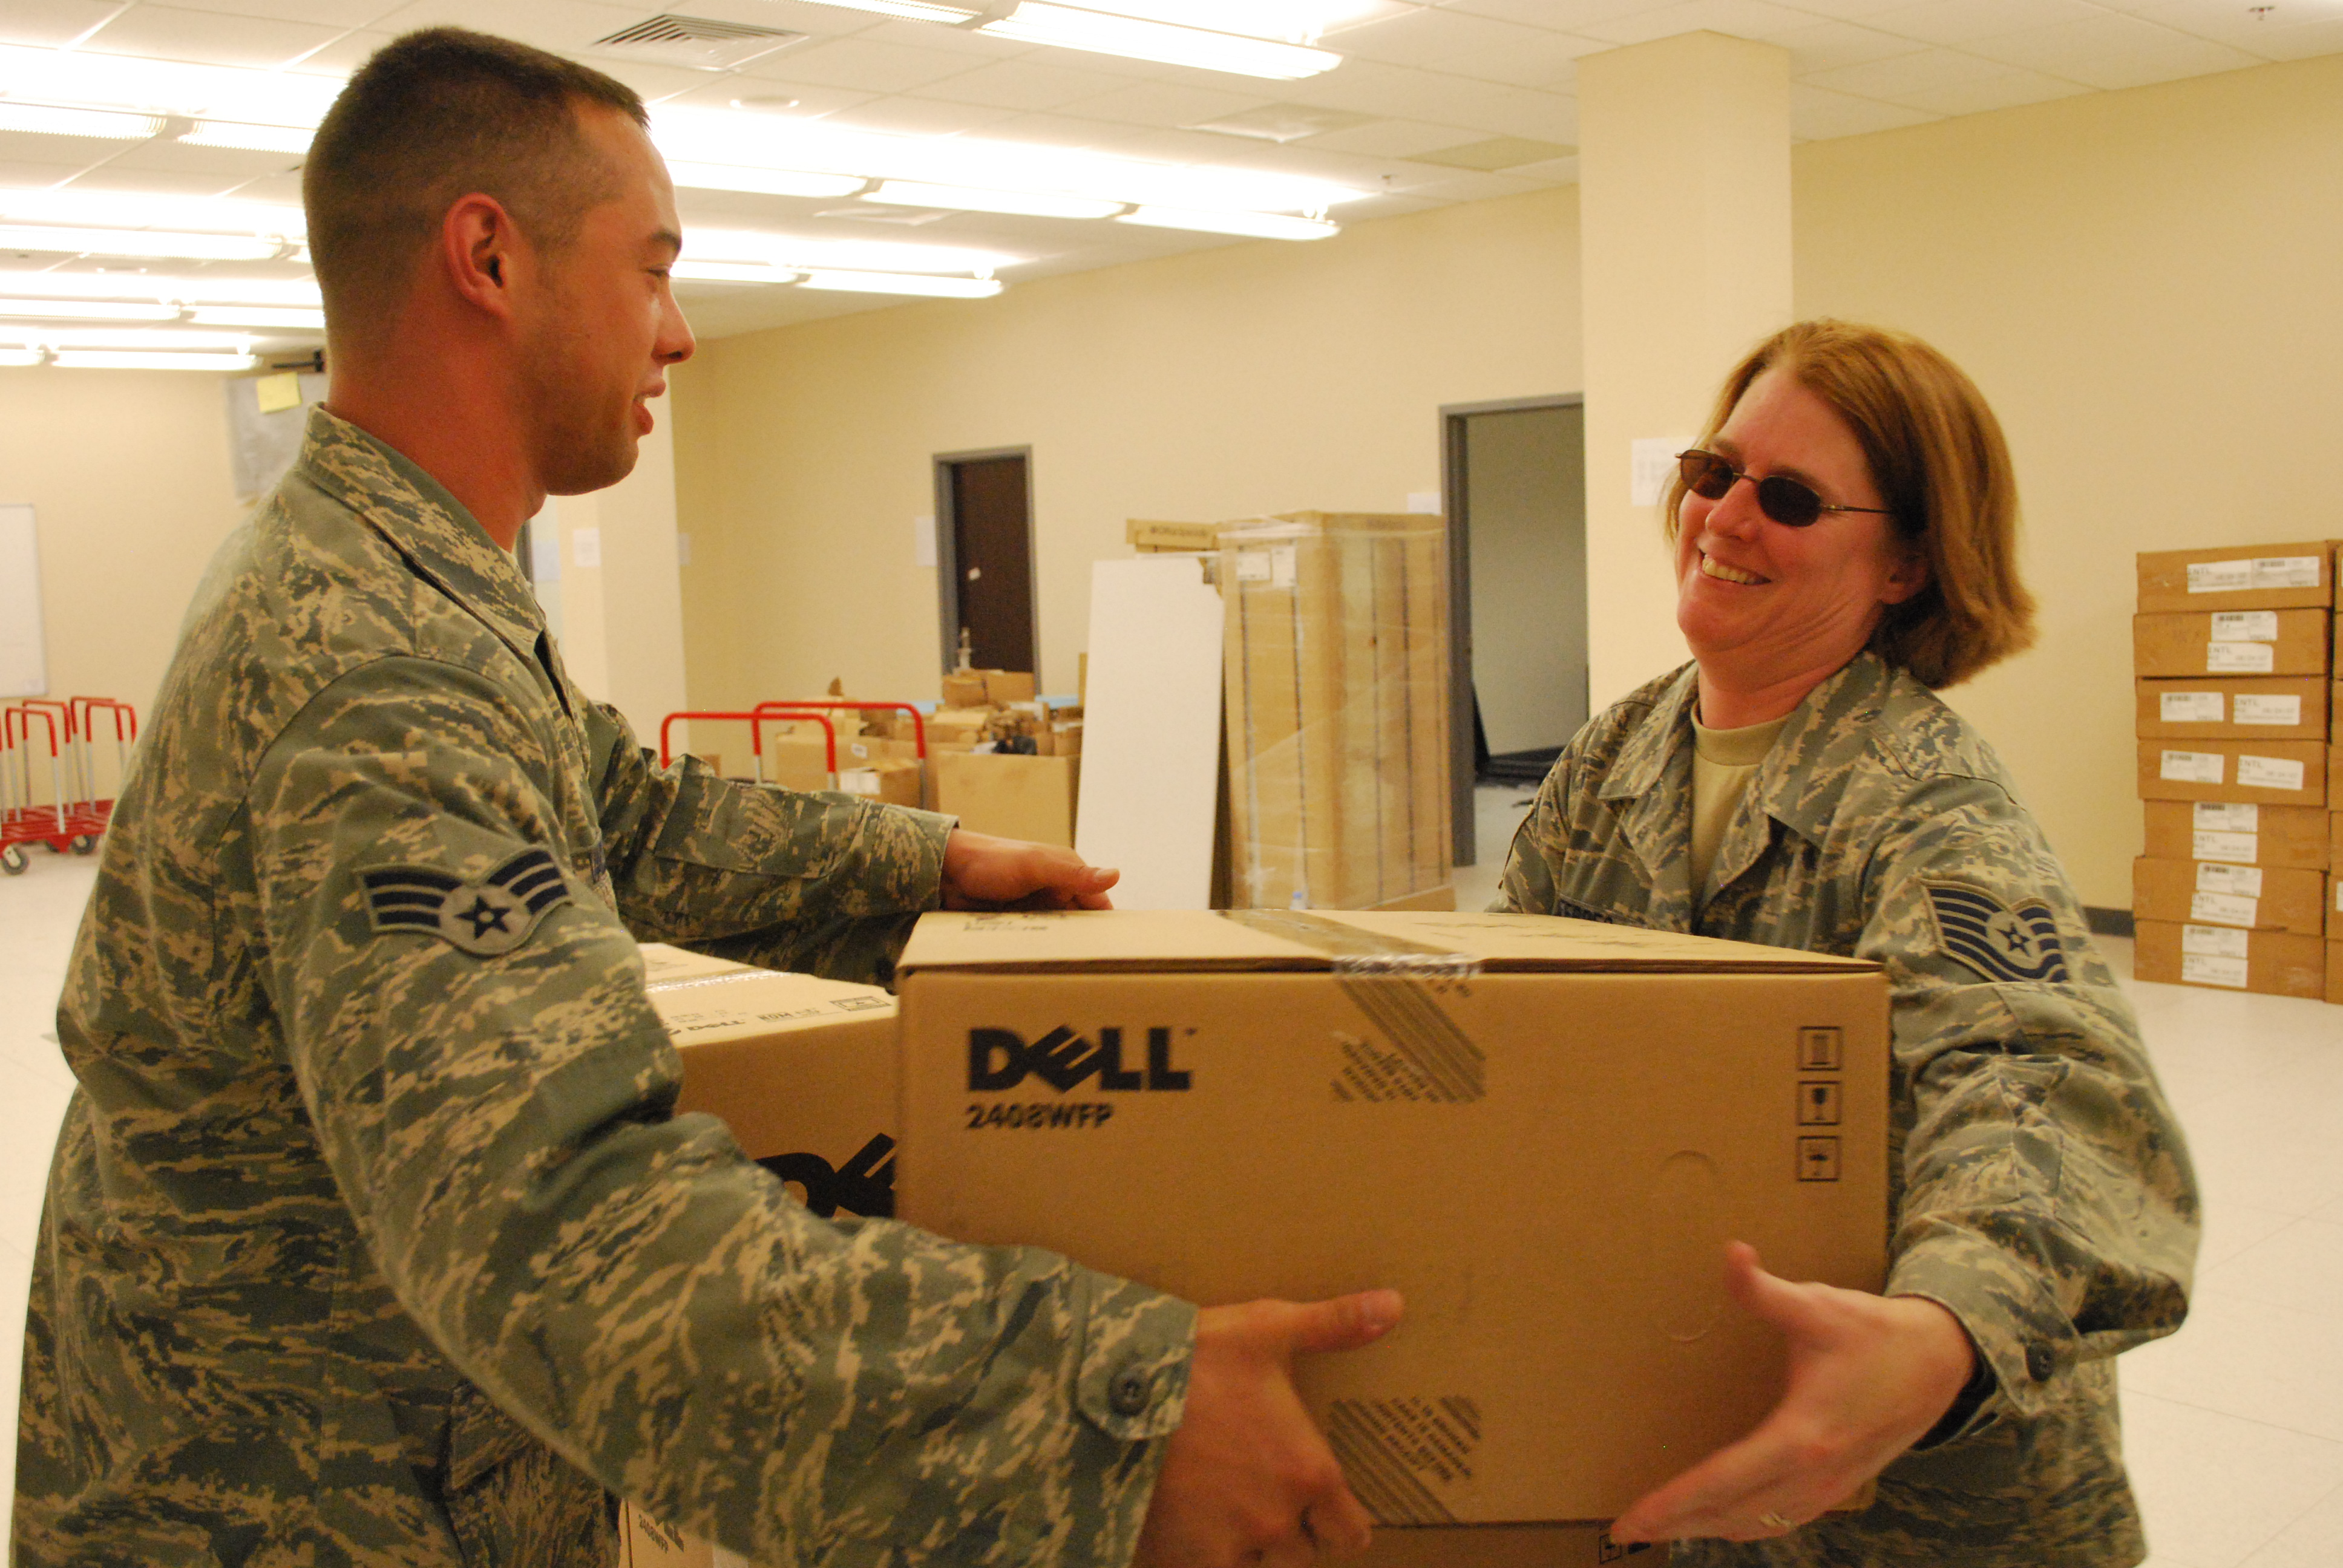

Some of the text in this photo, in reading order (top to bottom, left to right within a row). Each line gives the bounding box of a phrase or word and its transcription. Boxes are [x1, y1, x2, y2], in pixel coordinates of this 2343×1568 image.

[969, 1024, 1192, 1093] DELL
[966, 1102, 1113, 1129] 2408WFP
[754, 1132, 897, 1218] DE
